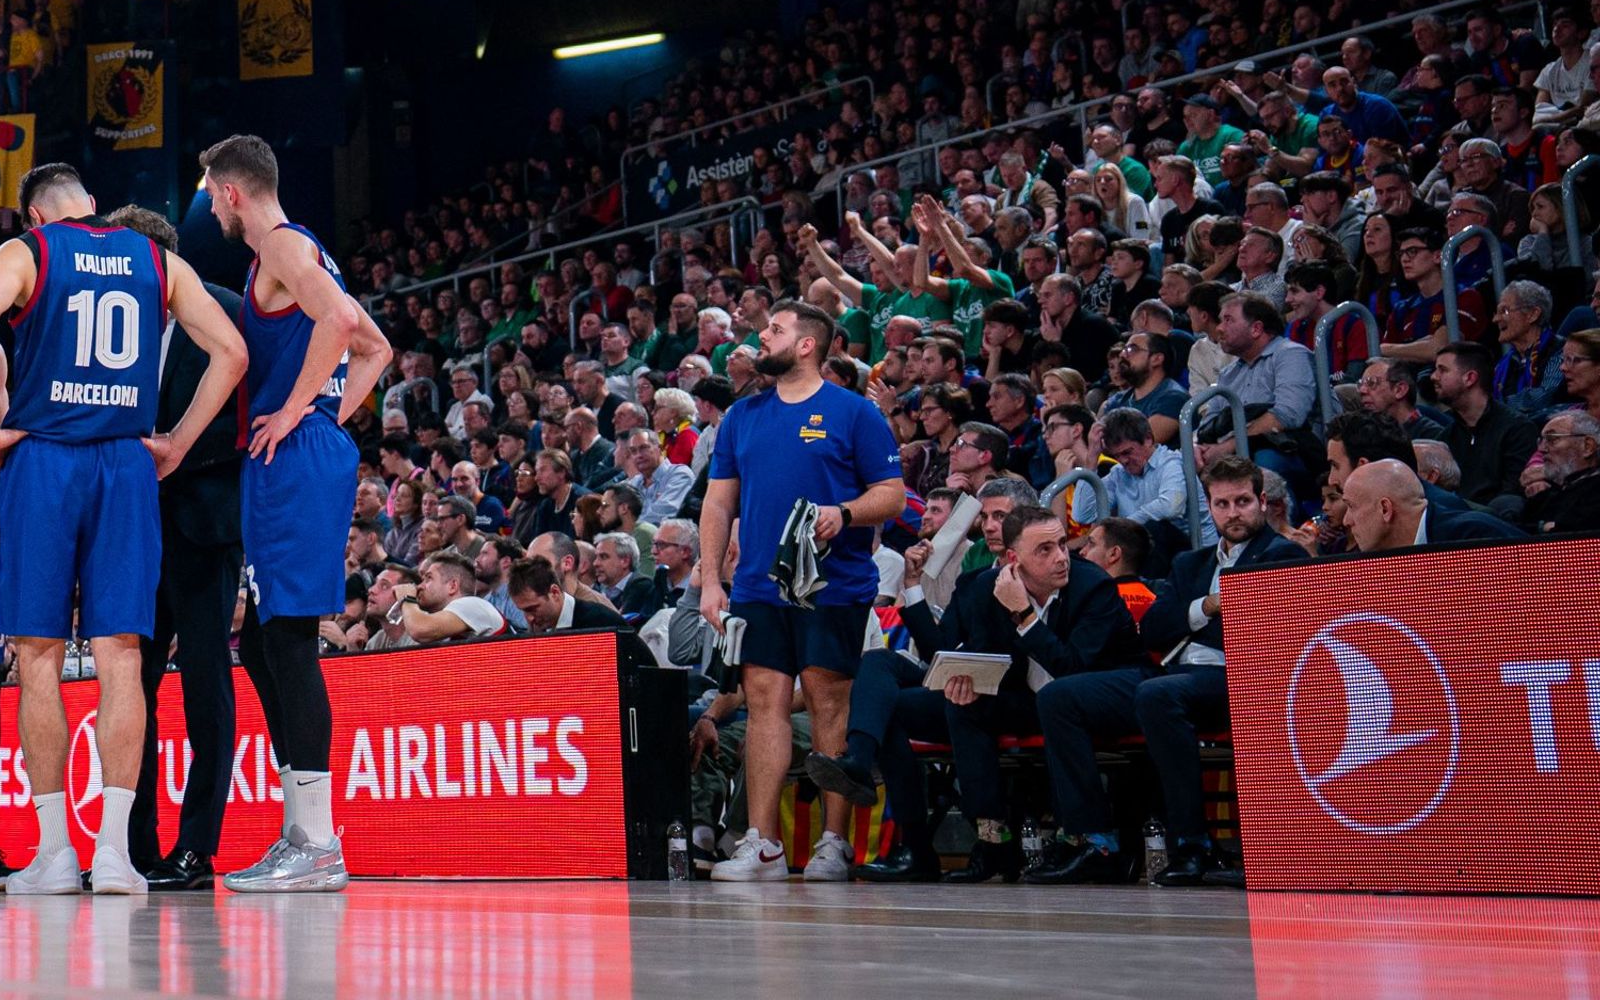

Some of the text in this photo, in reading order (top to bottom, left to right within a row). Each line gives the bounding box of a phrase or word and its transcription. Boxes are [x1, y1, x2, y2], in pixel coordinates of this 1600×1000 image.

[74, 252, 133, 276] KALINIC
[67, 289, 140, 369] 10
[50, 380, 139, 409] BARCELONA
[1499, 658, 1600, 775] T
[345, 715, 589, 801] AIRLINES
